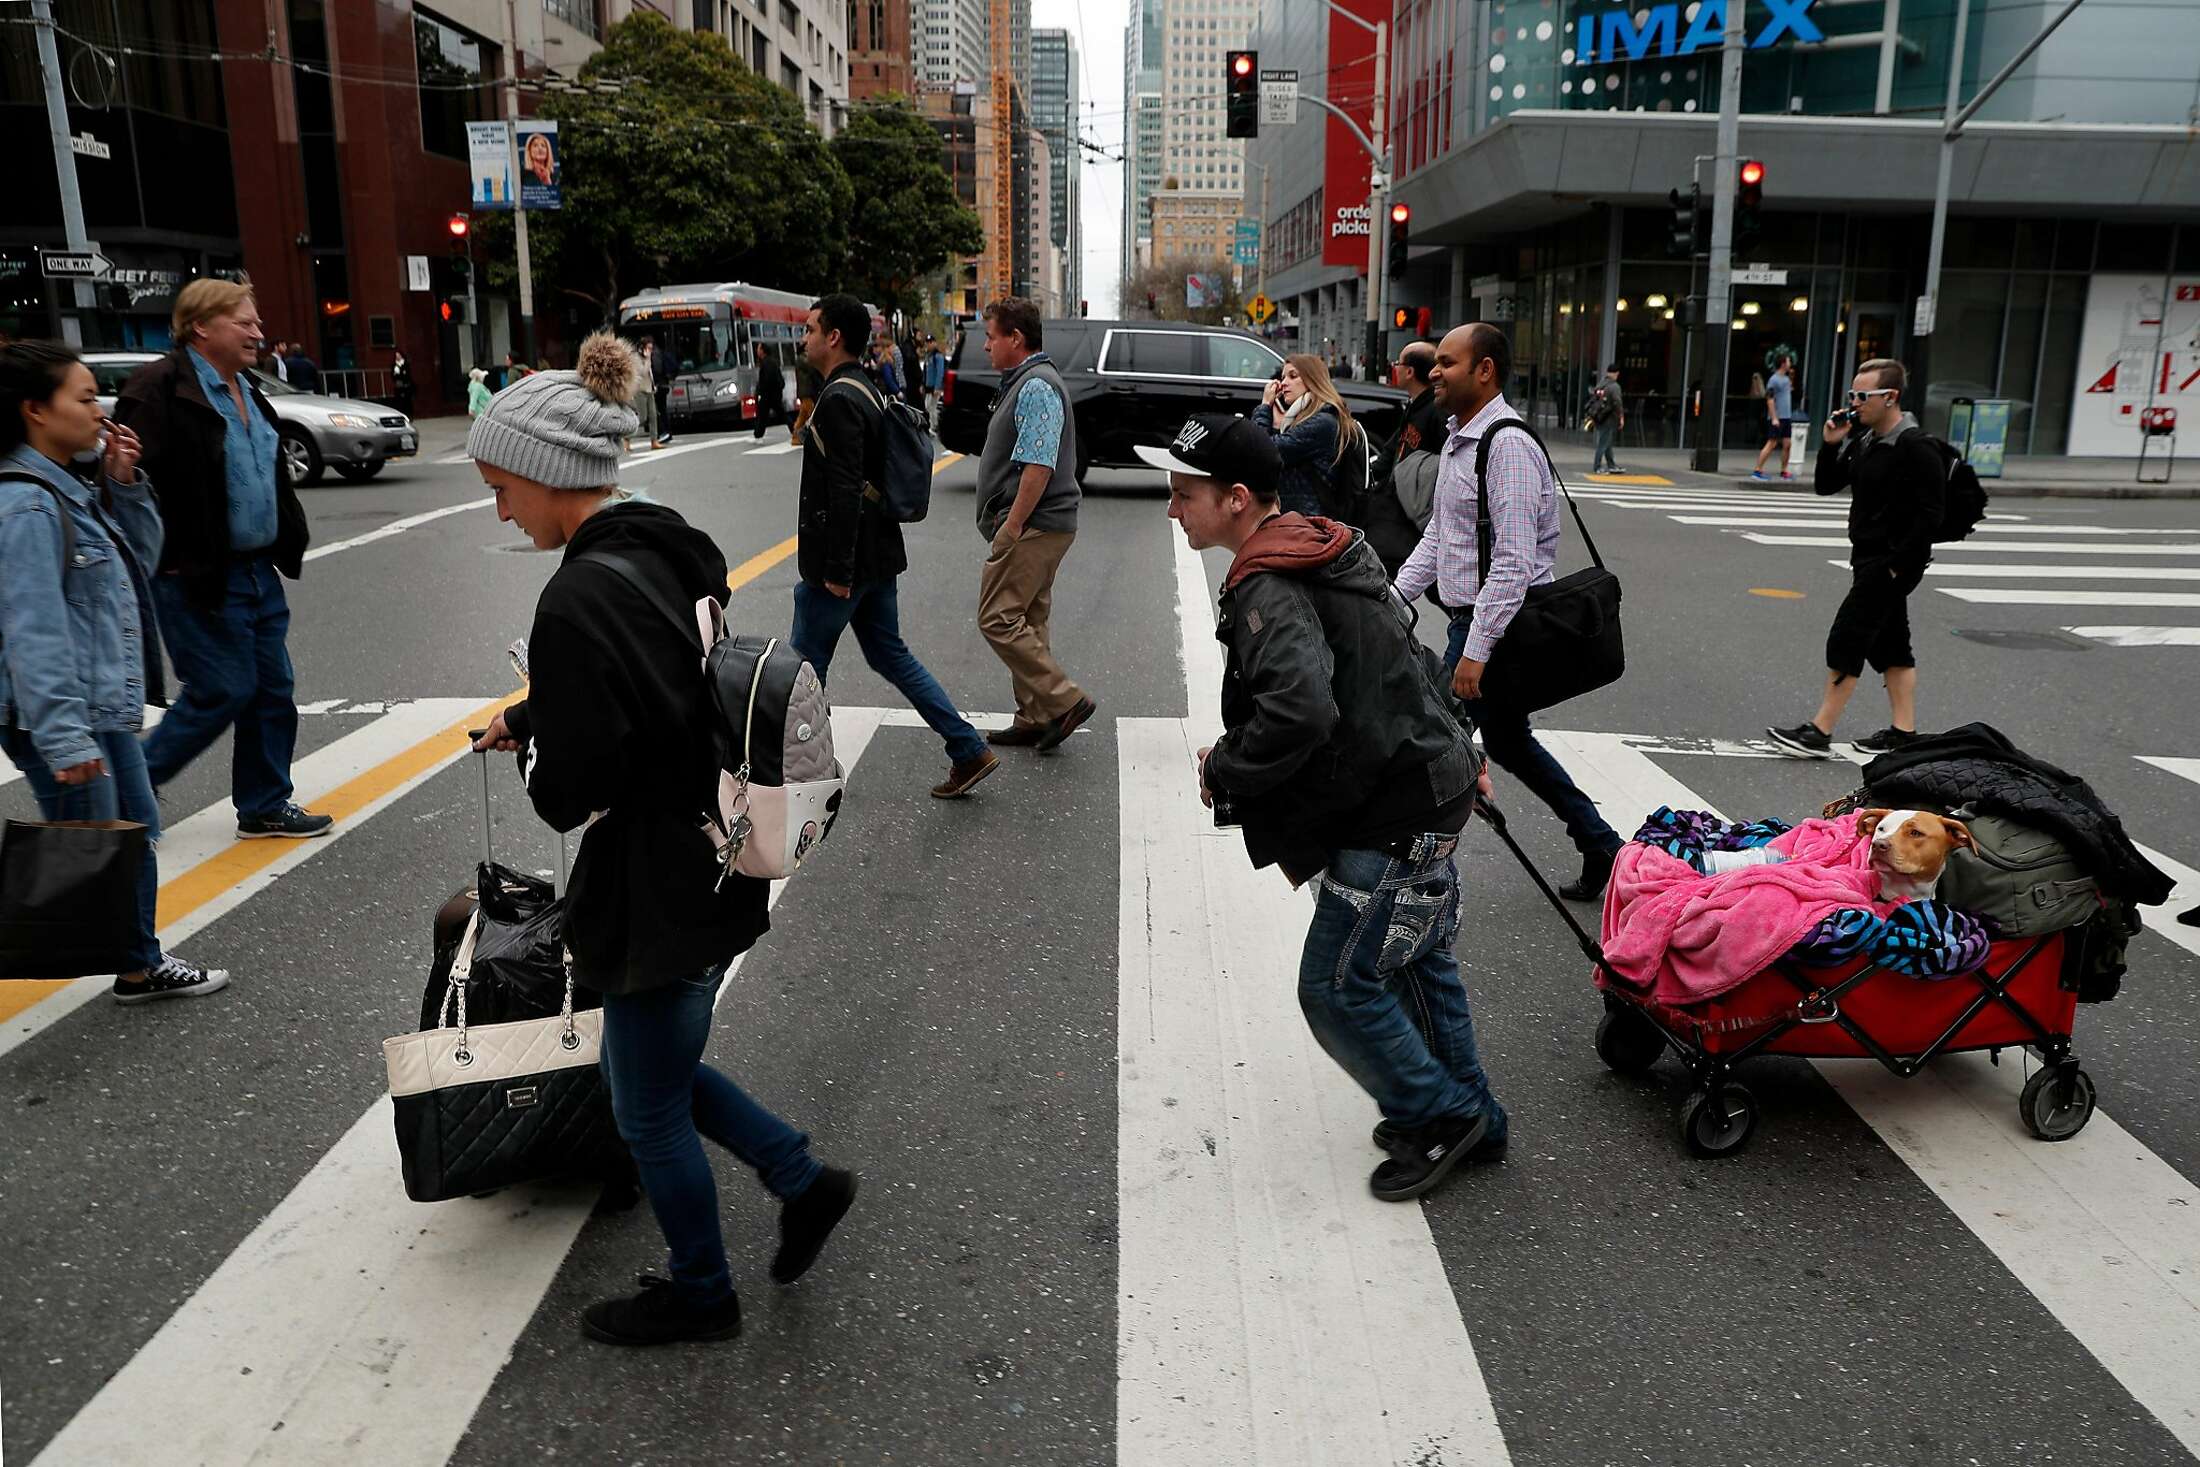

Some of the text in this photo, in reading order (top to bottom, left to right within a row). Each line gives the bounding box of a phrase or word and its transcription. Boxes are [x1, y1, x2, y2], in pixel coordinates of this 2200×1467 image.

[1576, 0, 1824, 66] IMAX
[72, 137, 109, 158] MISSION
[1337, 204, 1371, 219] orde
[1332, 219, 1371, 237] picku
[50, 258, 91, 271] ONE WAY
